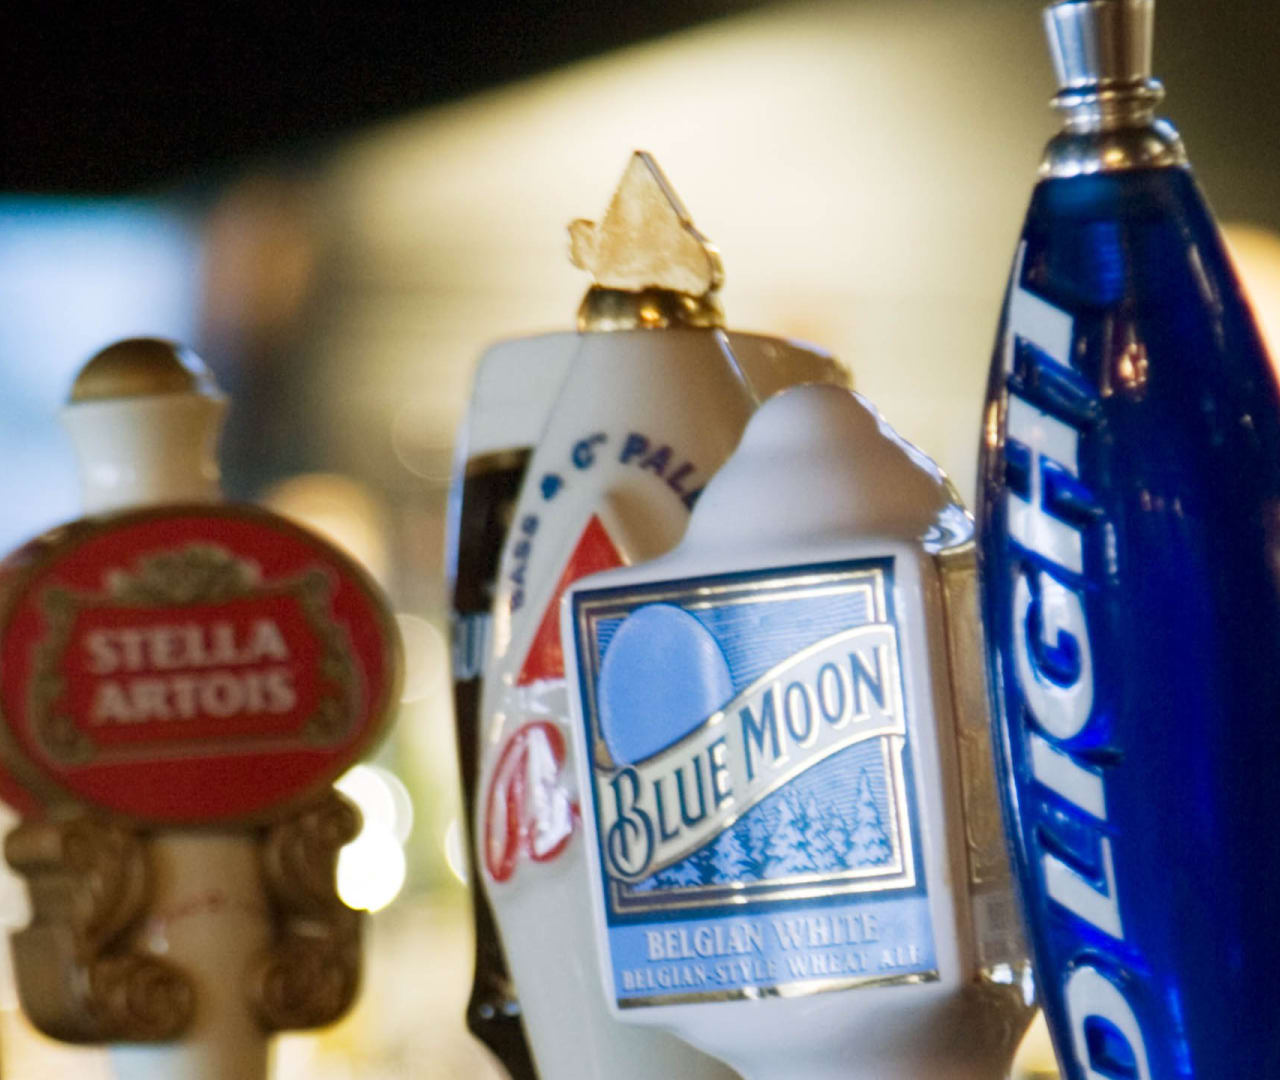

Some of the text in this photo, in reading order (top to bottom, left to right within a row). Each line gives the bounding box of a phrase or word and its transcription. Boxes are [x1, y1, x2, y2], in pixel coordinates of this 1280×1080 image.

[1004, 239, 1125, 941] LIGHT
[86, 617, 288, 676] STELLA
[92, 667, 297, 726] ARTOIS
[606, 736, 735, 878] BLUE
[738, 642, 894, 784] MOON
[645, 912, 880, 963] BELGIAN WHITE
[621, 943, 921, 993] BELGIAN-STYLE WHEAT ALE
